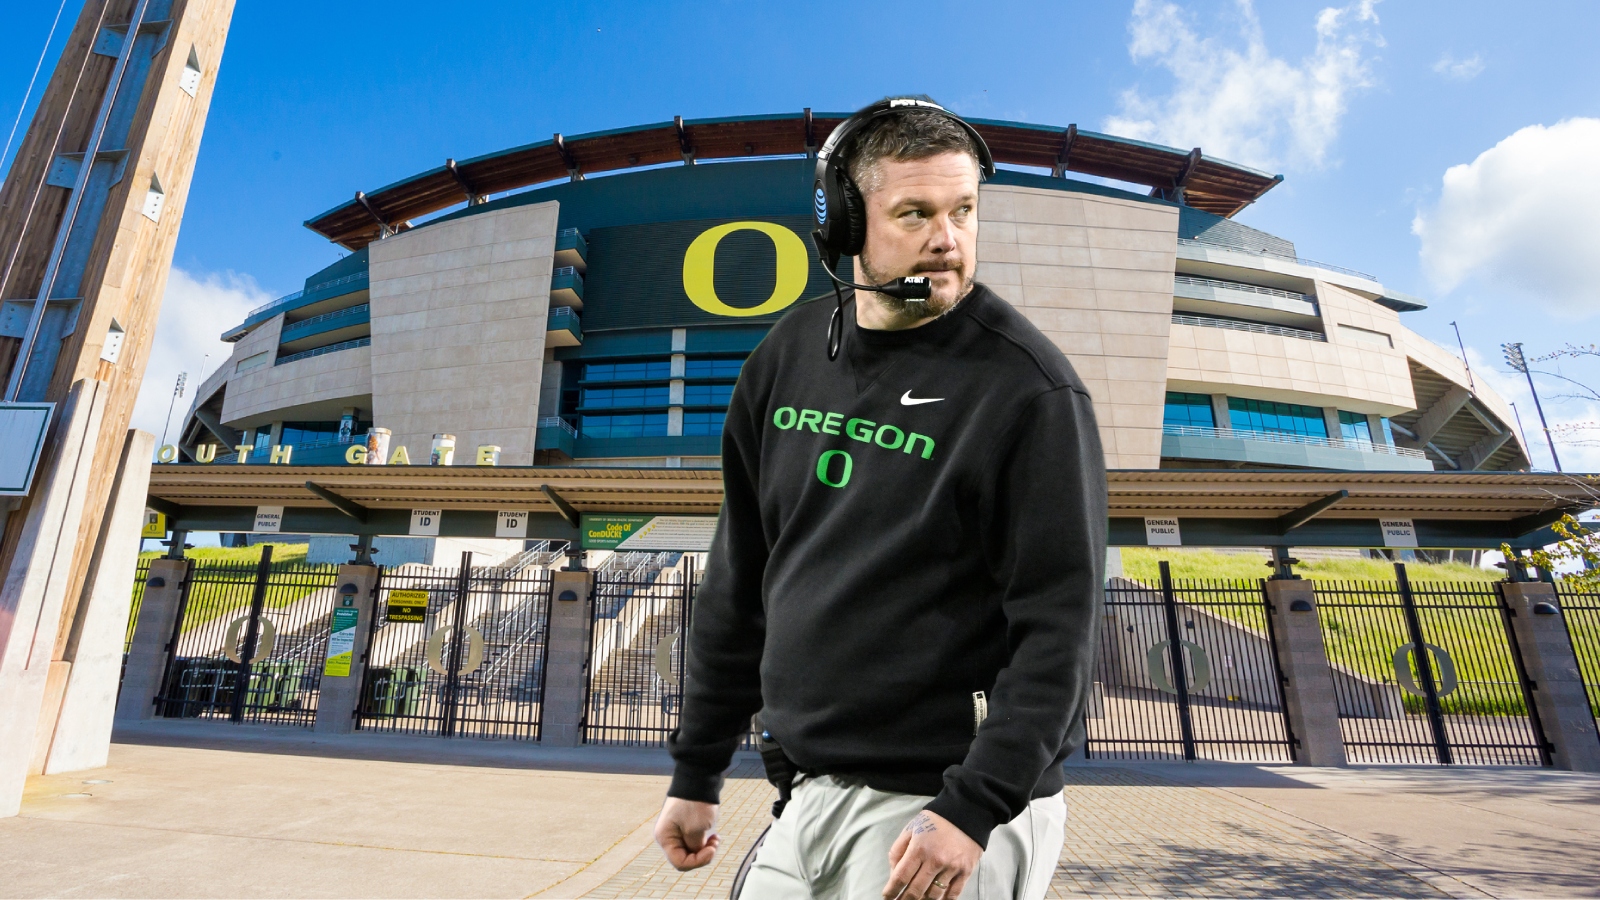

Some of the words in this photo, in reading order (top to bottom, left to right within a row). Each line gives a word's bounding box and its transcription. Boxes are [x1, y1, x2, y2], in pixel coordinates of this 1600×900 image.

[682, 220, 809, 317] O
[773, 406, 936, 460] OREGON
[157, 443, 293, 464] OUTH
[345, 444, 497, 466] GATE
[816, 449, 853, 488] O
[419, 517, 431, 526] ID
[506, 519, 518, 528] ID
[606, 523, 623, 531] Code
[623, 523, 632, 531] Of
